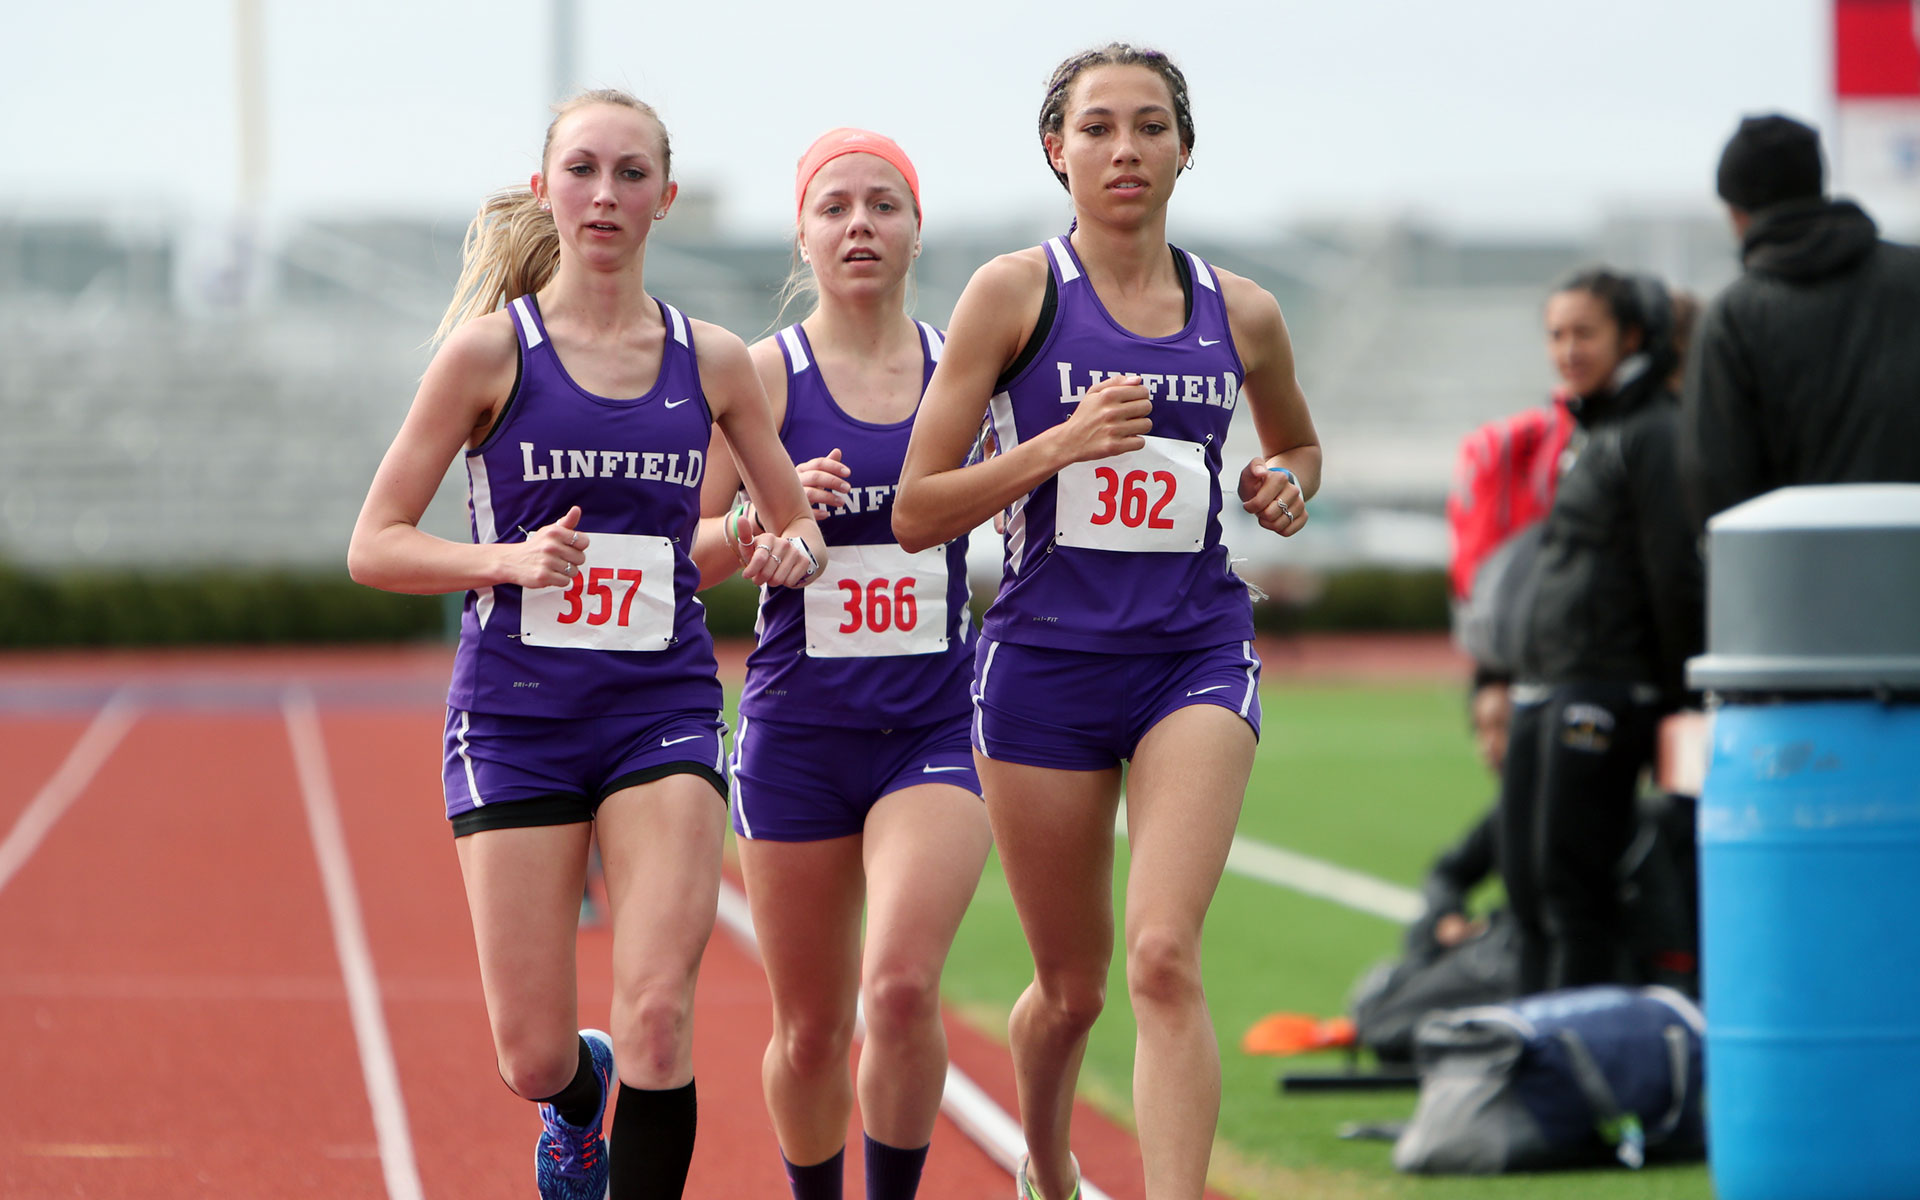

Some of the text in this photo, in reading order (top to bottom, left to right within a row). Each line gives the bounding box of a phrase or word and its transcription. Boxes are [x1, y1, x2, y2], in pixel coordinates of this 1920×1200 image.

[1057, 362, 1237, 410] LFIELD
[520, 442, 703, 488] LINFIELD
[1090, 467, 1177, 530] 362
[557, 567, 642, 628] 357
[837, 577, 918, 634] 366
